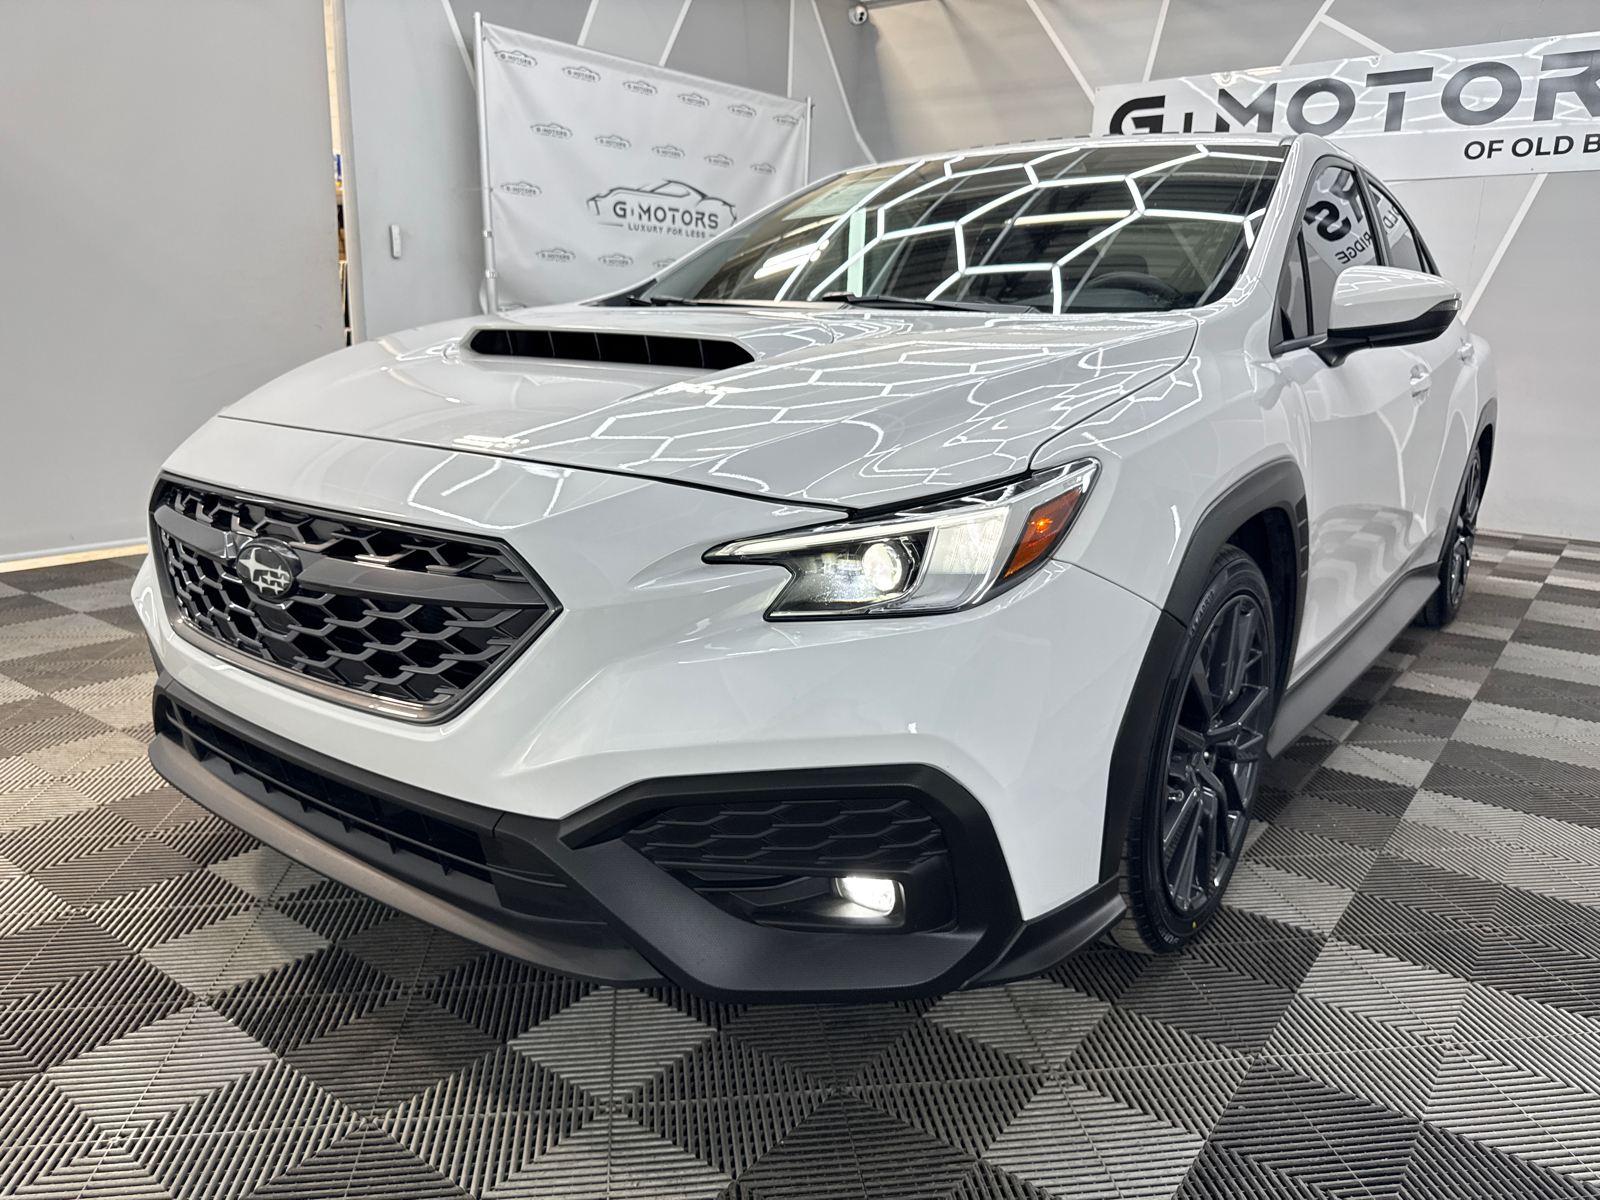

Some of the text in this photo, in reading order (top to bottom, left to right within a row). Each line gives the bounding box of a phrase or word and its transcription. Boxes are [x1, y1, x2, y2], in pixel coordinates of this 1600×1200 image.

[1464, 133, 1600, 160] OF OLD B
[638, 203, 719, 229] MOTORS
[628, 222, 706, 239] LUXURY FOR LESS
